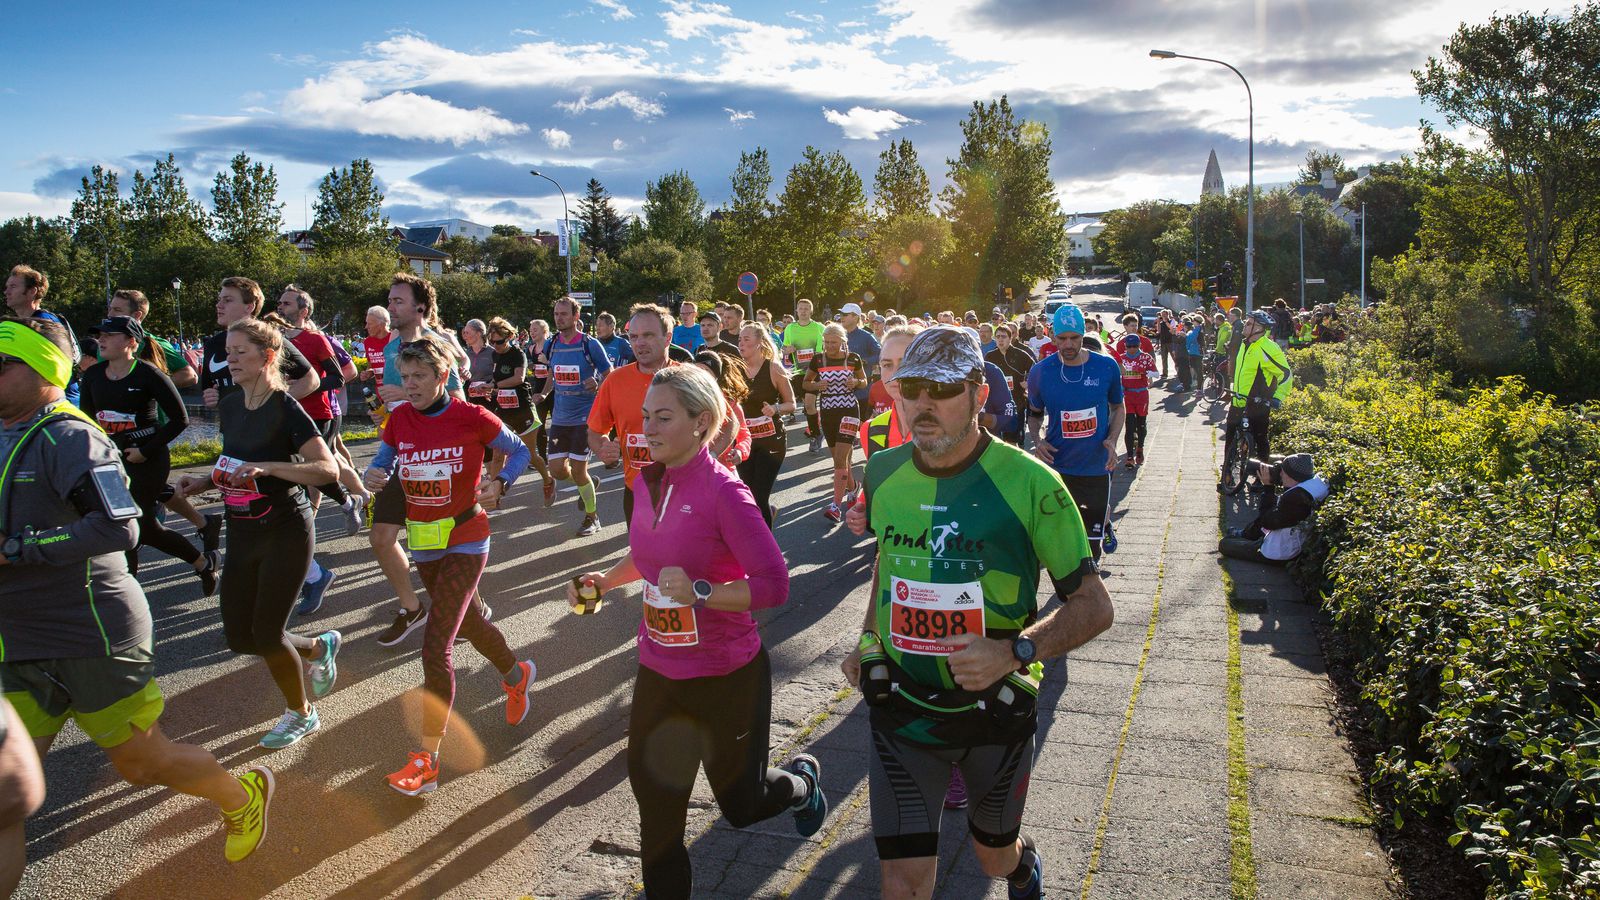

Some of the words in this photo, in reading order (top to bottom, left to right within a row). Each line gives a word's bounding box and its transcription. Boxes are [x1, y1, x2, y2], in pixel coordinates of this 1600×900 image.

[1066, 419, 1093, 433] 6230
[406, 480, 442, 497] 6426
[900, 606, 968, 640] 3898
[912, 642, 955, 652] marathon.is
